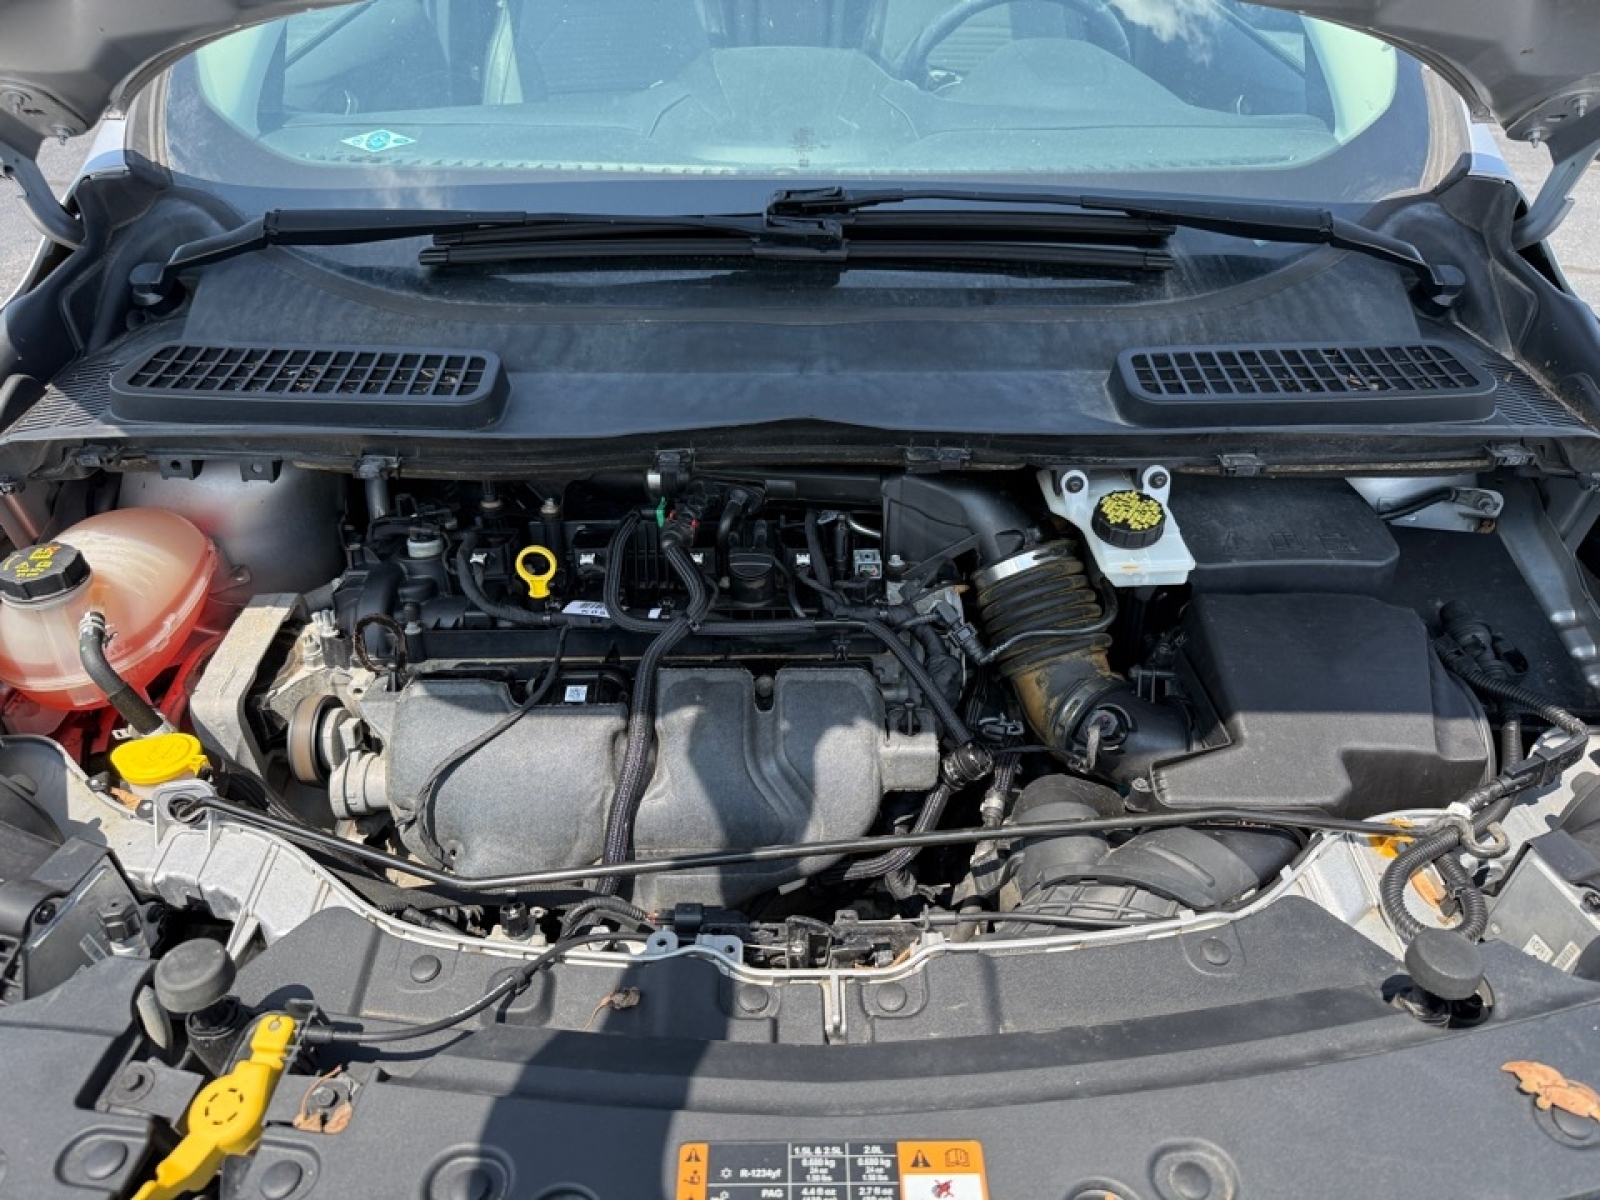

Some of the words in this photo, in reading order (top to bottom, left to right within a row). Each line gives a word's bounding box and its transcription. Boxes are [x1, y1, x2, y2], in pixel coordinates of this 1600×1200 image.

[815, 1146, 822, 1154] &
[823, 1146, 844, 1155] 2.5L
[863, 1145, 884, 1154] 2.0L
[740, 1168, 782, 1179] R-1234yf
[761, 1189, 784, 1198] PAG
[801, 1187, 816, 1196] 4.4
[858, 1187, 872, 1195] 2.7
